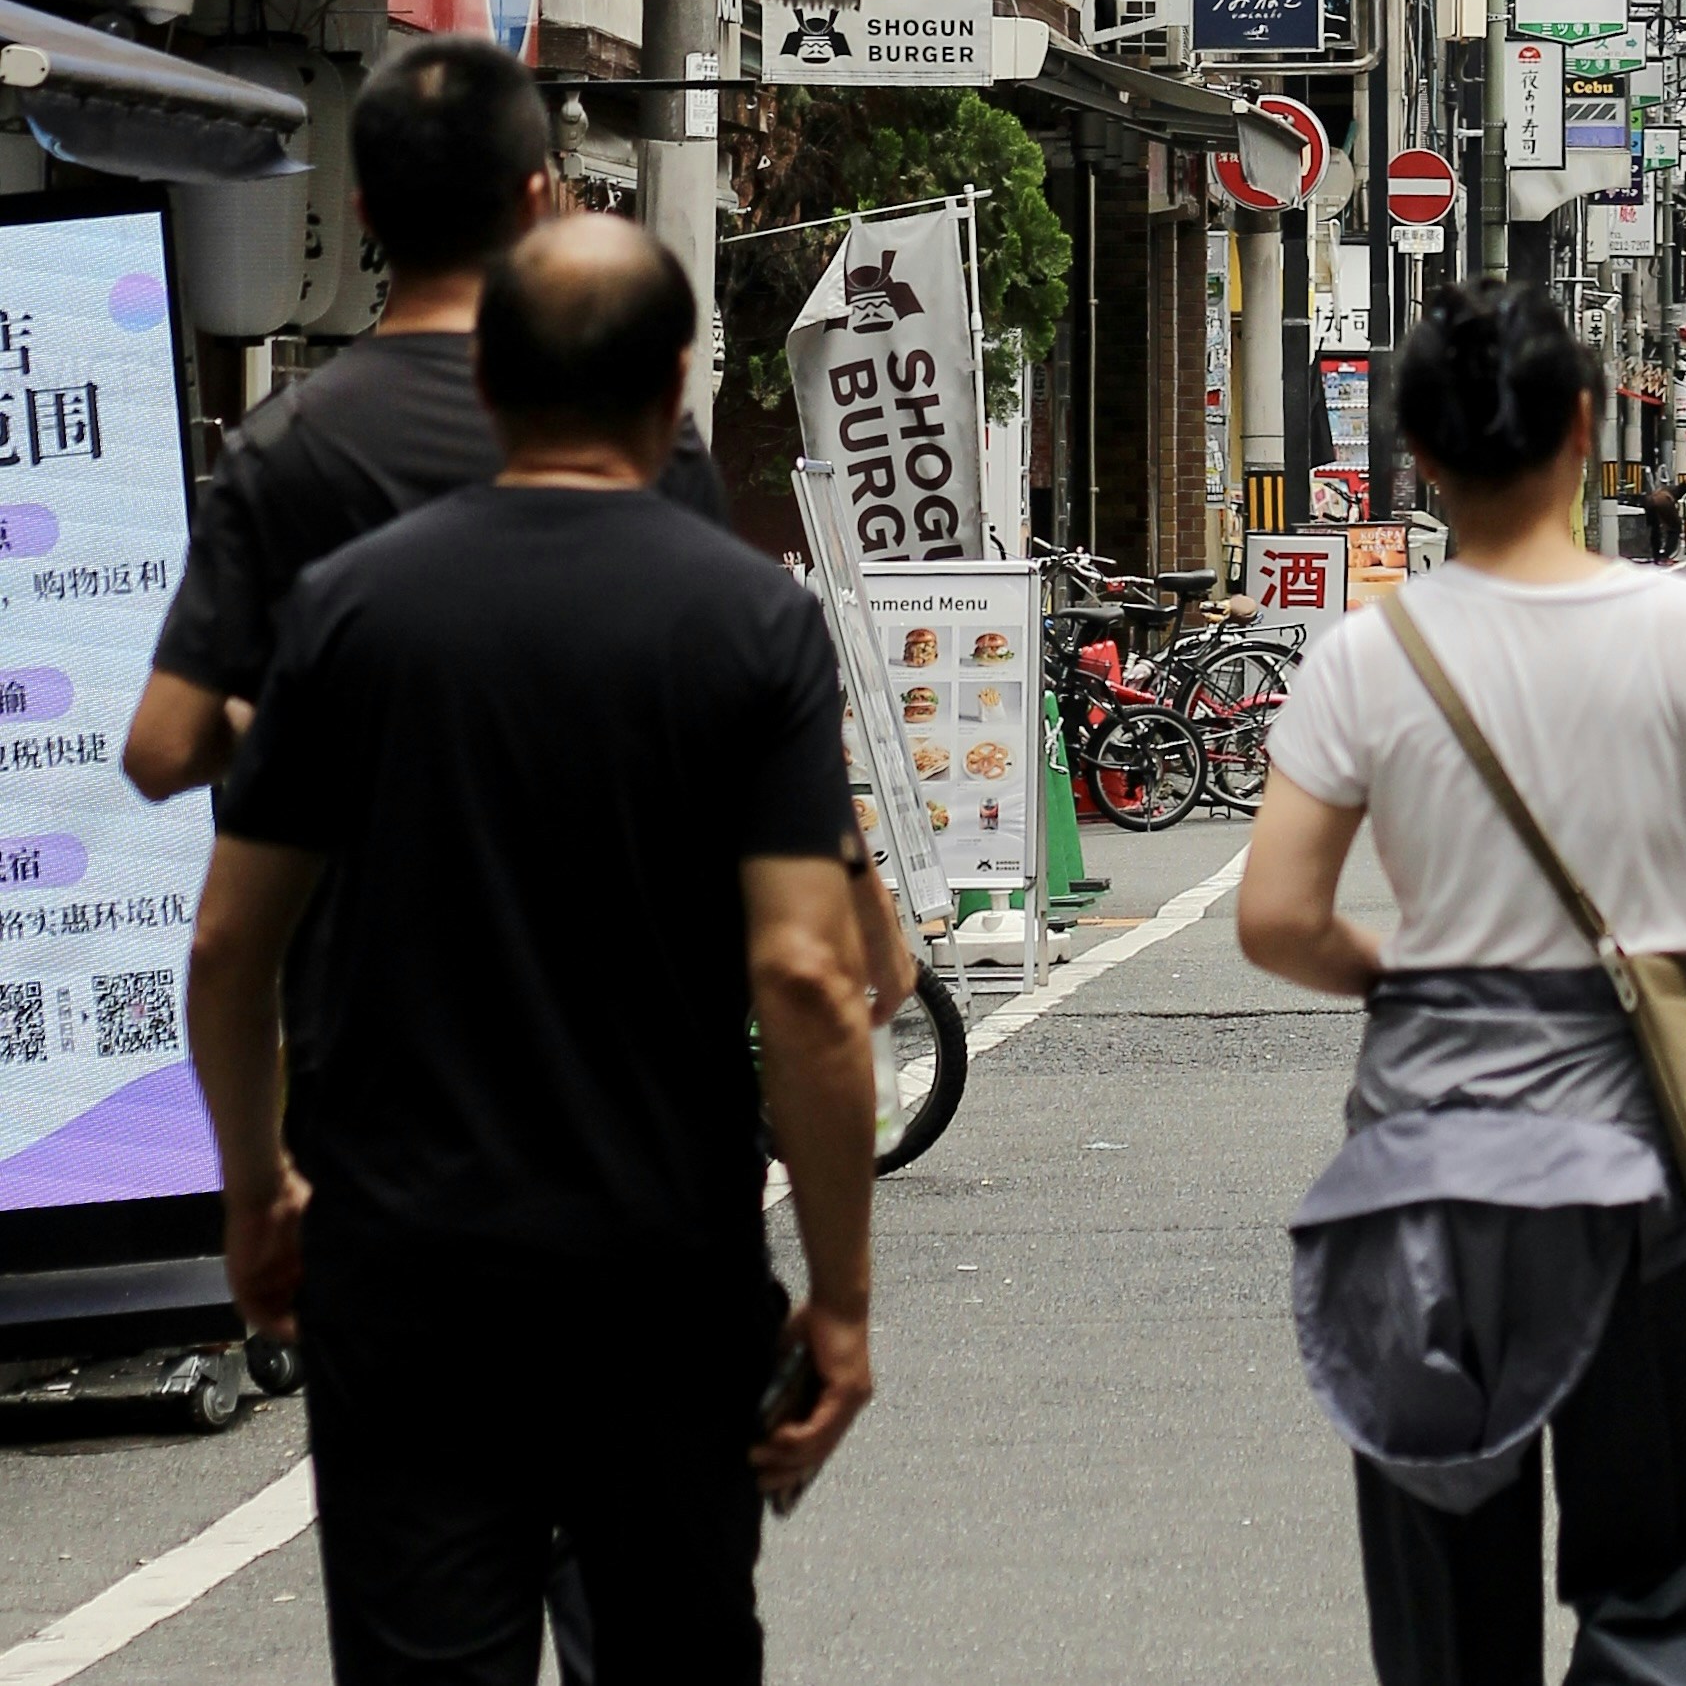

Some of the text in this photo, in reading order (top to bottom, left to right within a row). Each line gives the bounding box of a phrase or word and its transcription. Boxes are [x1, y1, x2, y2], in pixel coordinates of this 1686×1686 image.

[867, 18, 974, 38] SHOGUN
[1541, 23, 1601, 37] 三ツ寺筋
[868, 45, 975, 64] BURGER
[1573, 80, 1614, 95] Cebu
[828, 358, 910, 561] BURG
[1259, 549, 1329, 609] 酒
[939, 596, 989, 612] Menu
